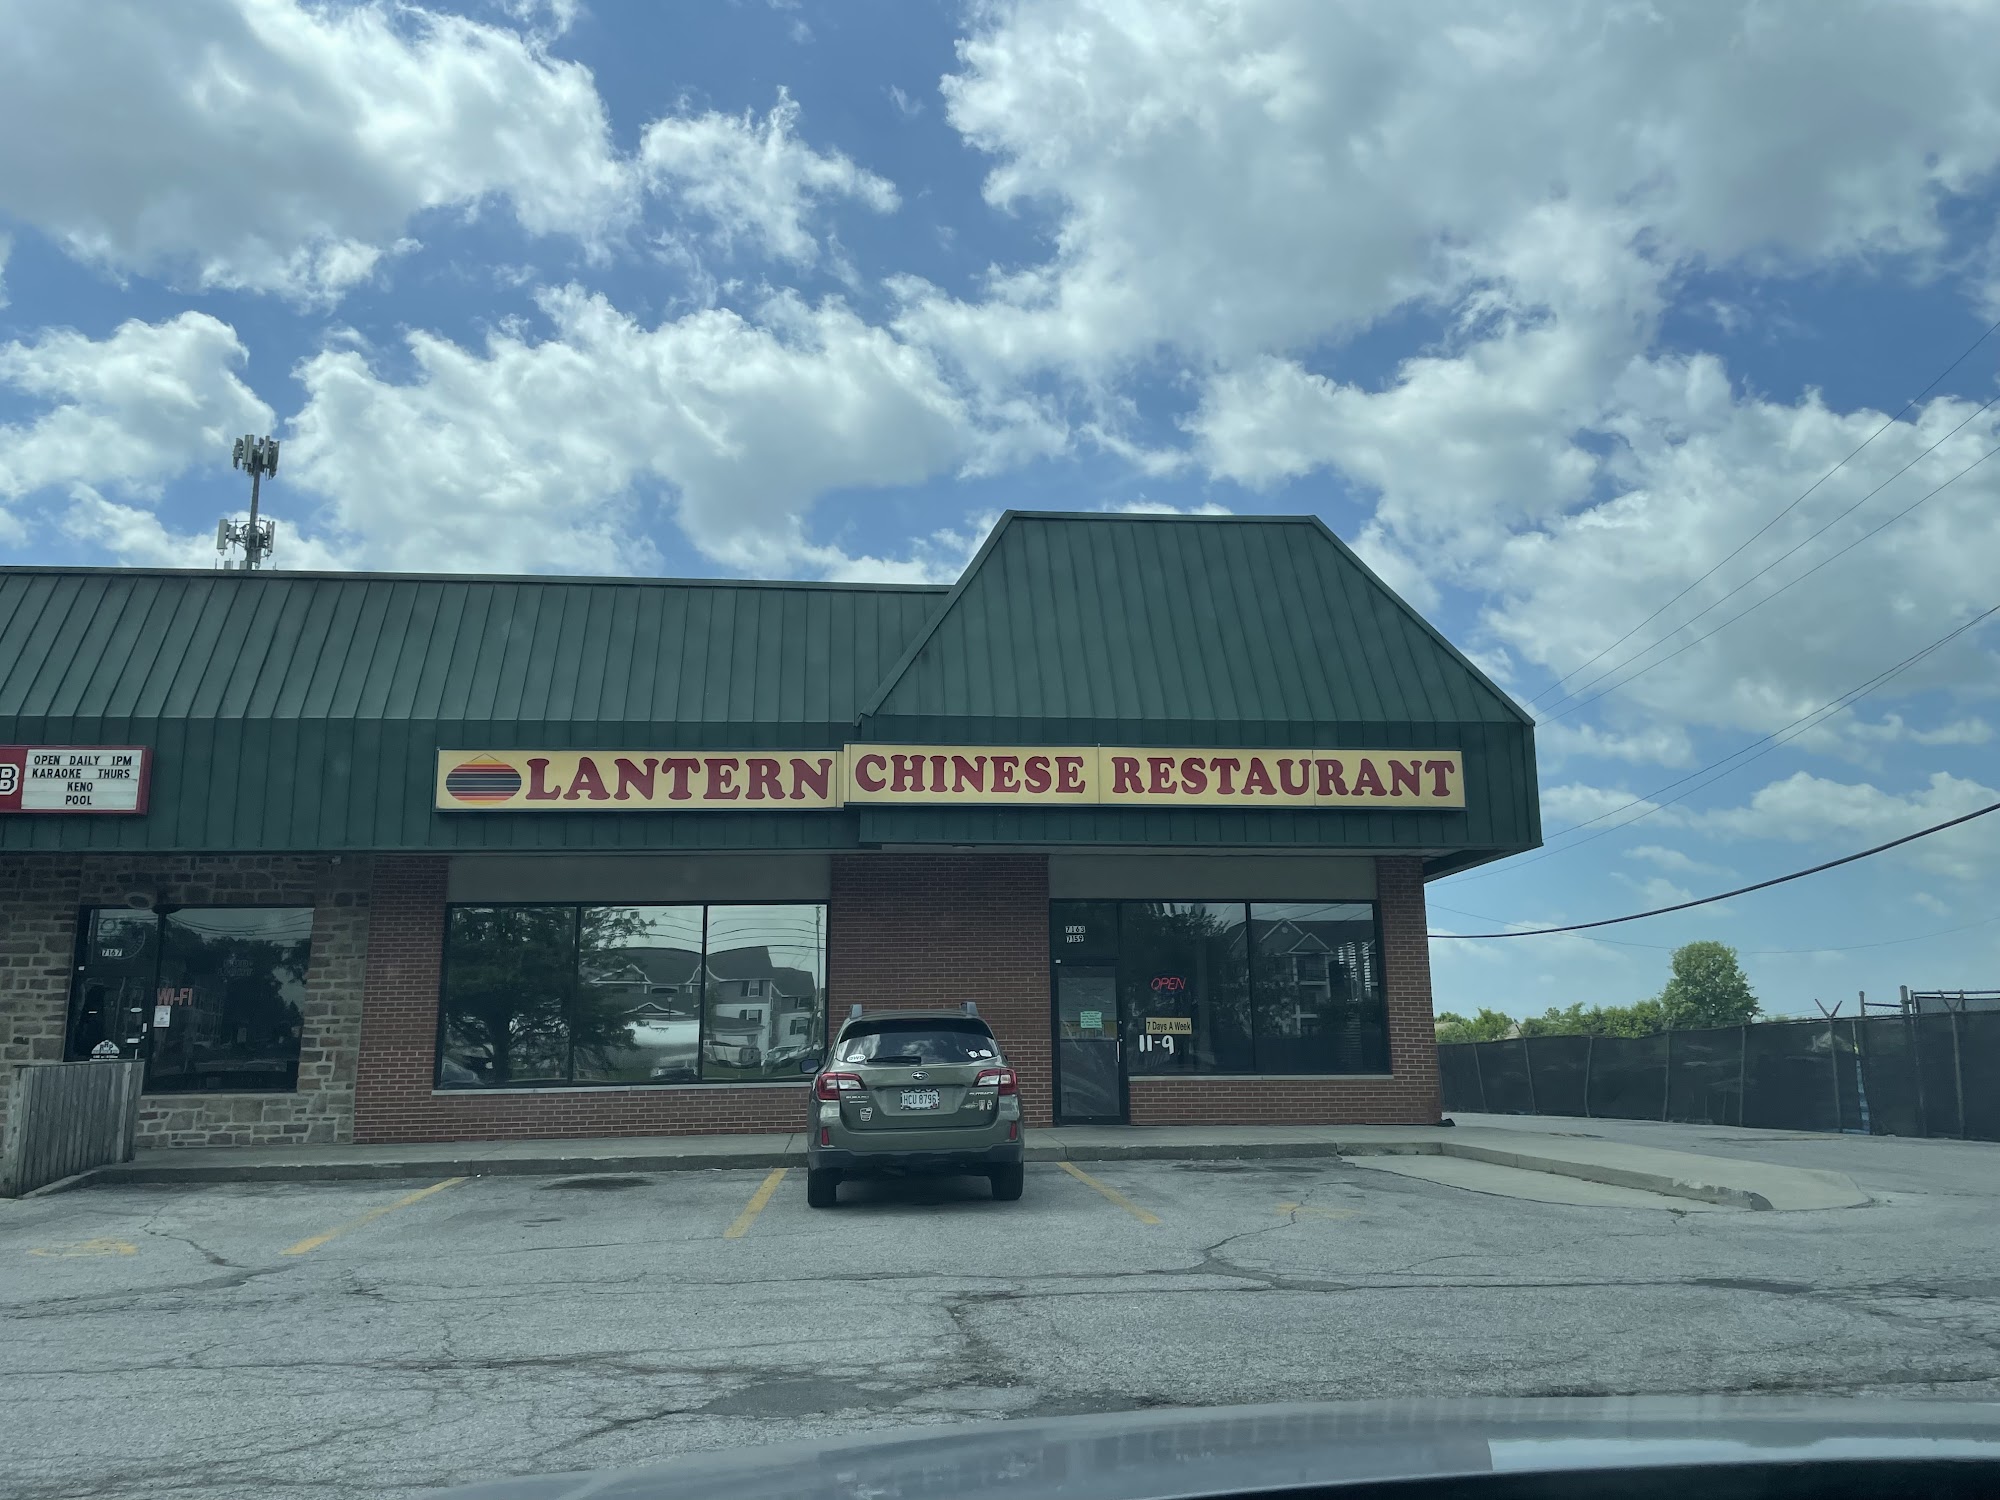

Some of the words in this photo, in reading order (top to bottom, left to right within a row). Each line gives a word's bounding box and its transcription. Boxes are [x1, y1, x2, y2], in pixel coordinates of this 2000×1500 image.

[33, 755, 60, 765] OPEN
[69, 755, 100, 766] DAILY
[111, 755, 132, 766] 1PM
[32, 768, 82, 778] KARAOKE
[98, 769, 131, 779] THURS
[525, 757, 833, 800] LANTERN
[855, 754, 1086, 793] CHINESE
[1112, 757, 1455, 797] RESTAURANT
[67, 782, 93, 792] KENO
[65, 795, 93, 805] POOL
[1151, 977, 1187, 990] OPEN
[157, 988, 193, 1005] WI-FI
[1147, 1022, 1151, 1030] 7
[1152, 1022, 1167, 1032] Days
[1168, 1022, 1173, 1030] A
[1174, 1021, 1191, 1030] Week
[1139, 1034, 1174, 1055] 11-9
